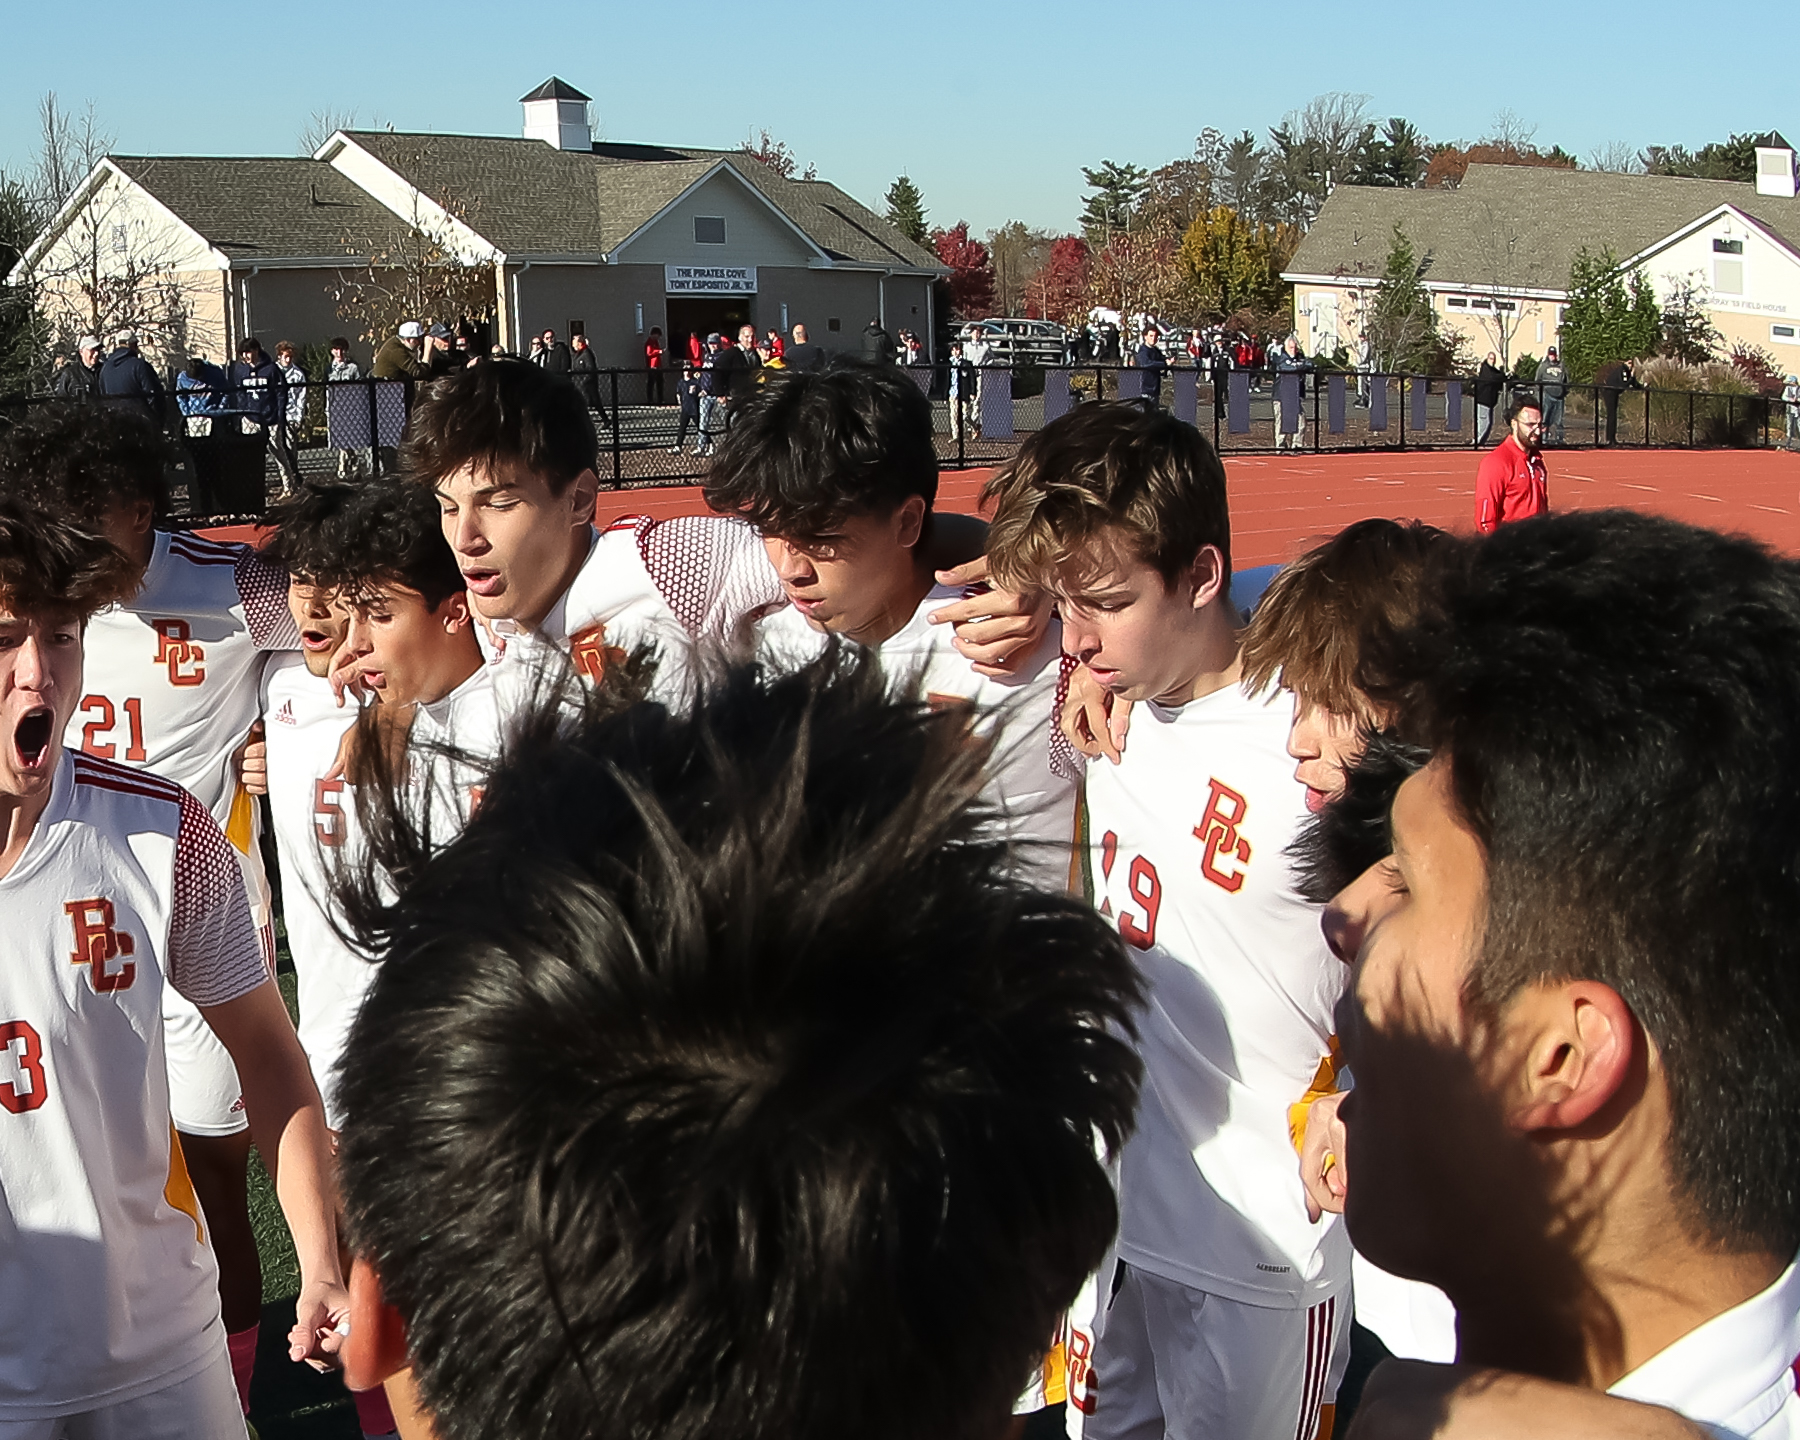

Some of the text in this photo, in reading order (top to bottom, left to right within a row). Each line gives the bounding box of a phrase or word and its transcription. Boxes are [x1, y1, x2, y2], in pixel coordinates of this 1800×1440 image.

[670, 281, 691, 289] TONY
[692, 281, 729, 290] ESPOSITO
[677, 269, 746, 278] THE PIRATES COVE
[1763, 304, 1787, 312] HOUSE
[152, 619, 205, 686] BC
[80, 694, 146, 761] 21
[315, 778, 347, 846] 5
[1192, 777, 1252, 893] BC
[1102, 829, 1162, 951] 19
[64, 896, 136, 993] BC
